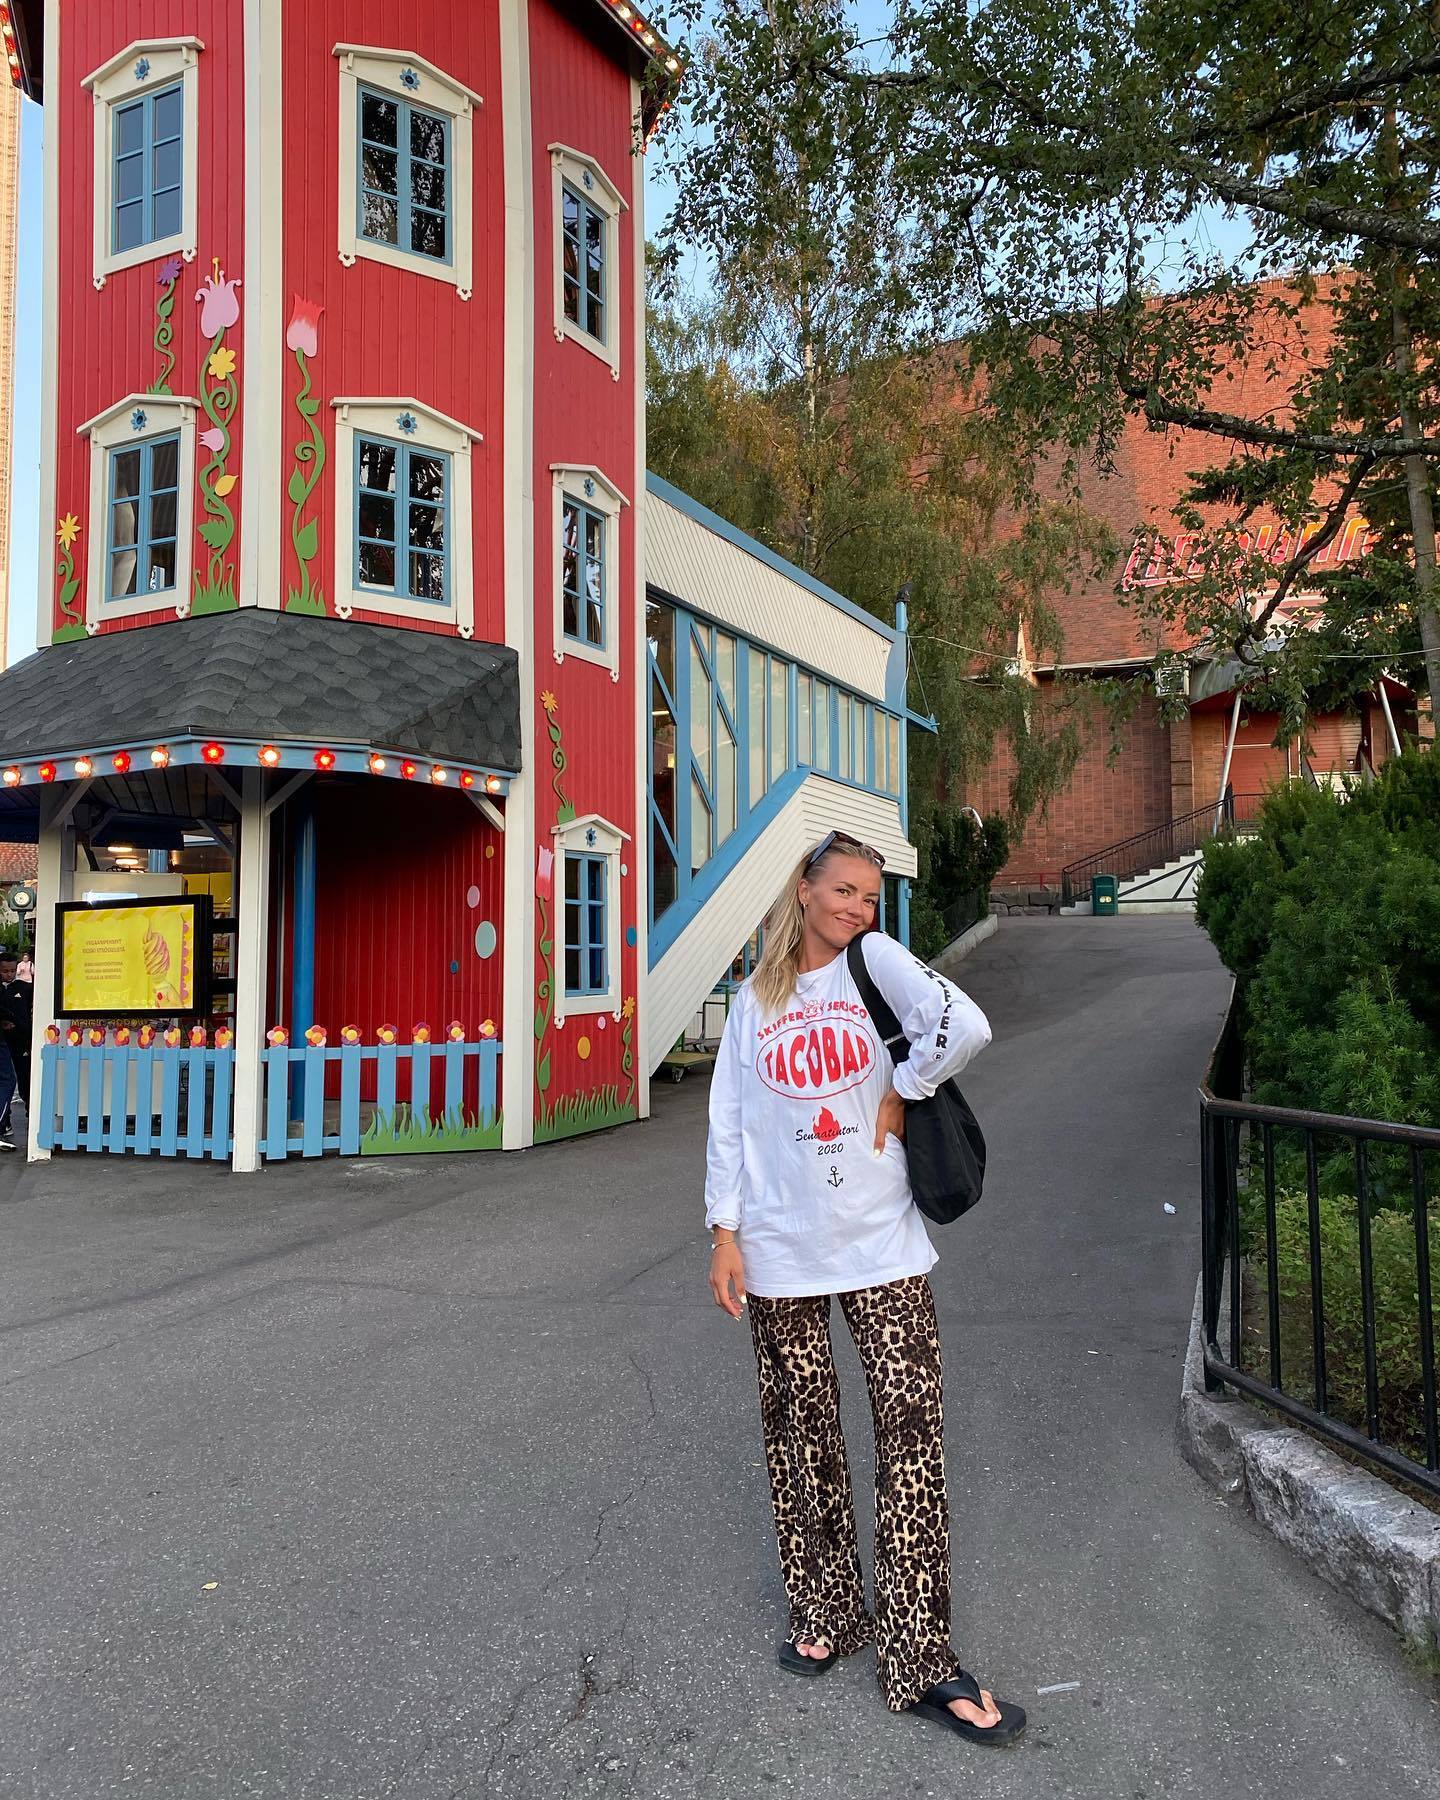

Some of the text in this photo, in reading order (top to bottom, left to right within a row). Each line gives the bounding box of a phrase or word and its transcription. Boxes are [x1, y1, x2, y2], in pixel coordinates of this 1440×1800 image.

[757, 1000, 868, 1040] SKIFFER SEKSCO
[764, 1026, 870, 1089] TACOBAR
[795, 1123, 860, 1142] Senaatintori
[817, 1142, 844, 1156] 2020
